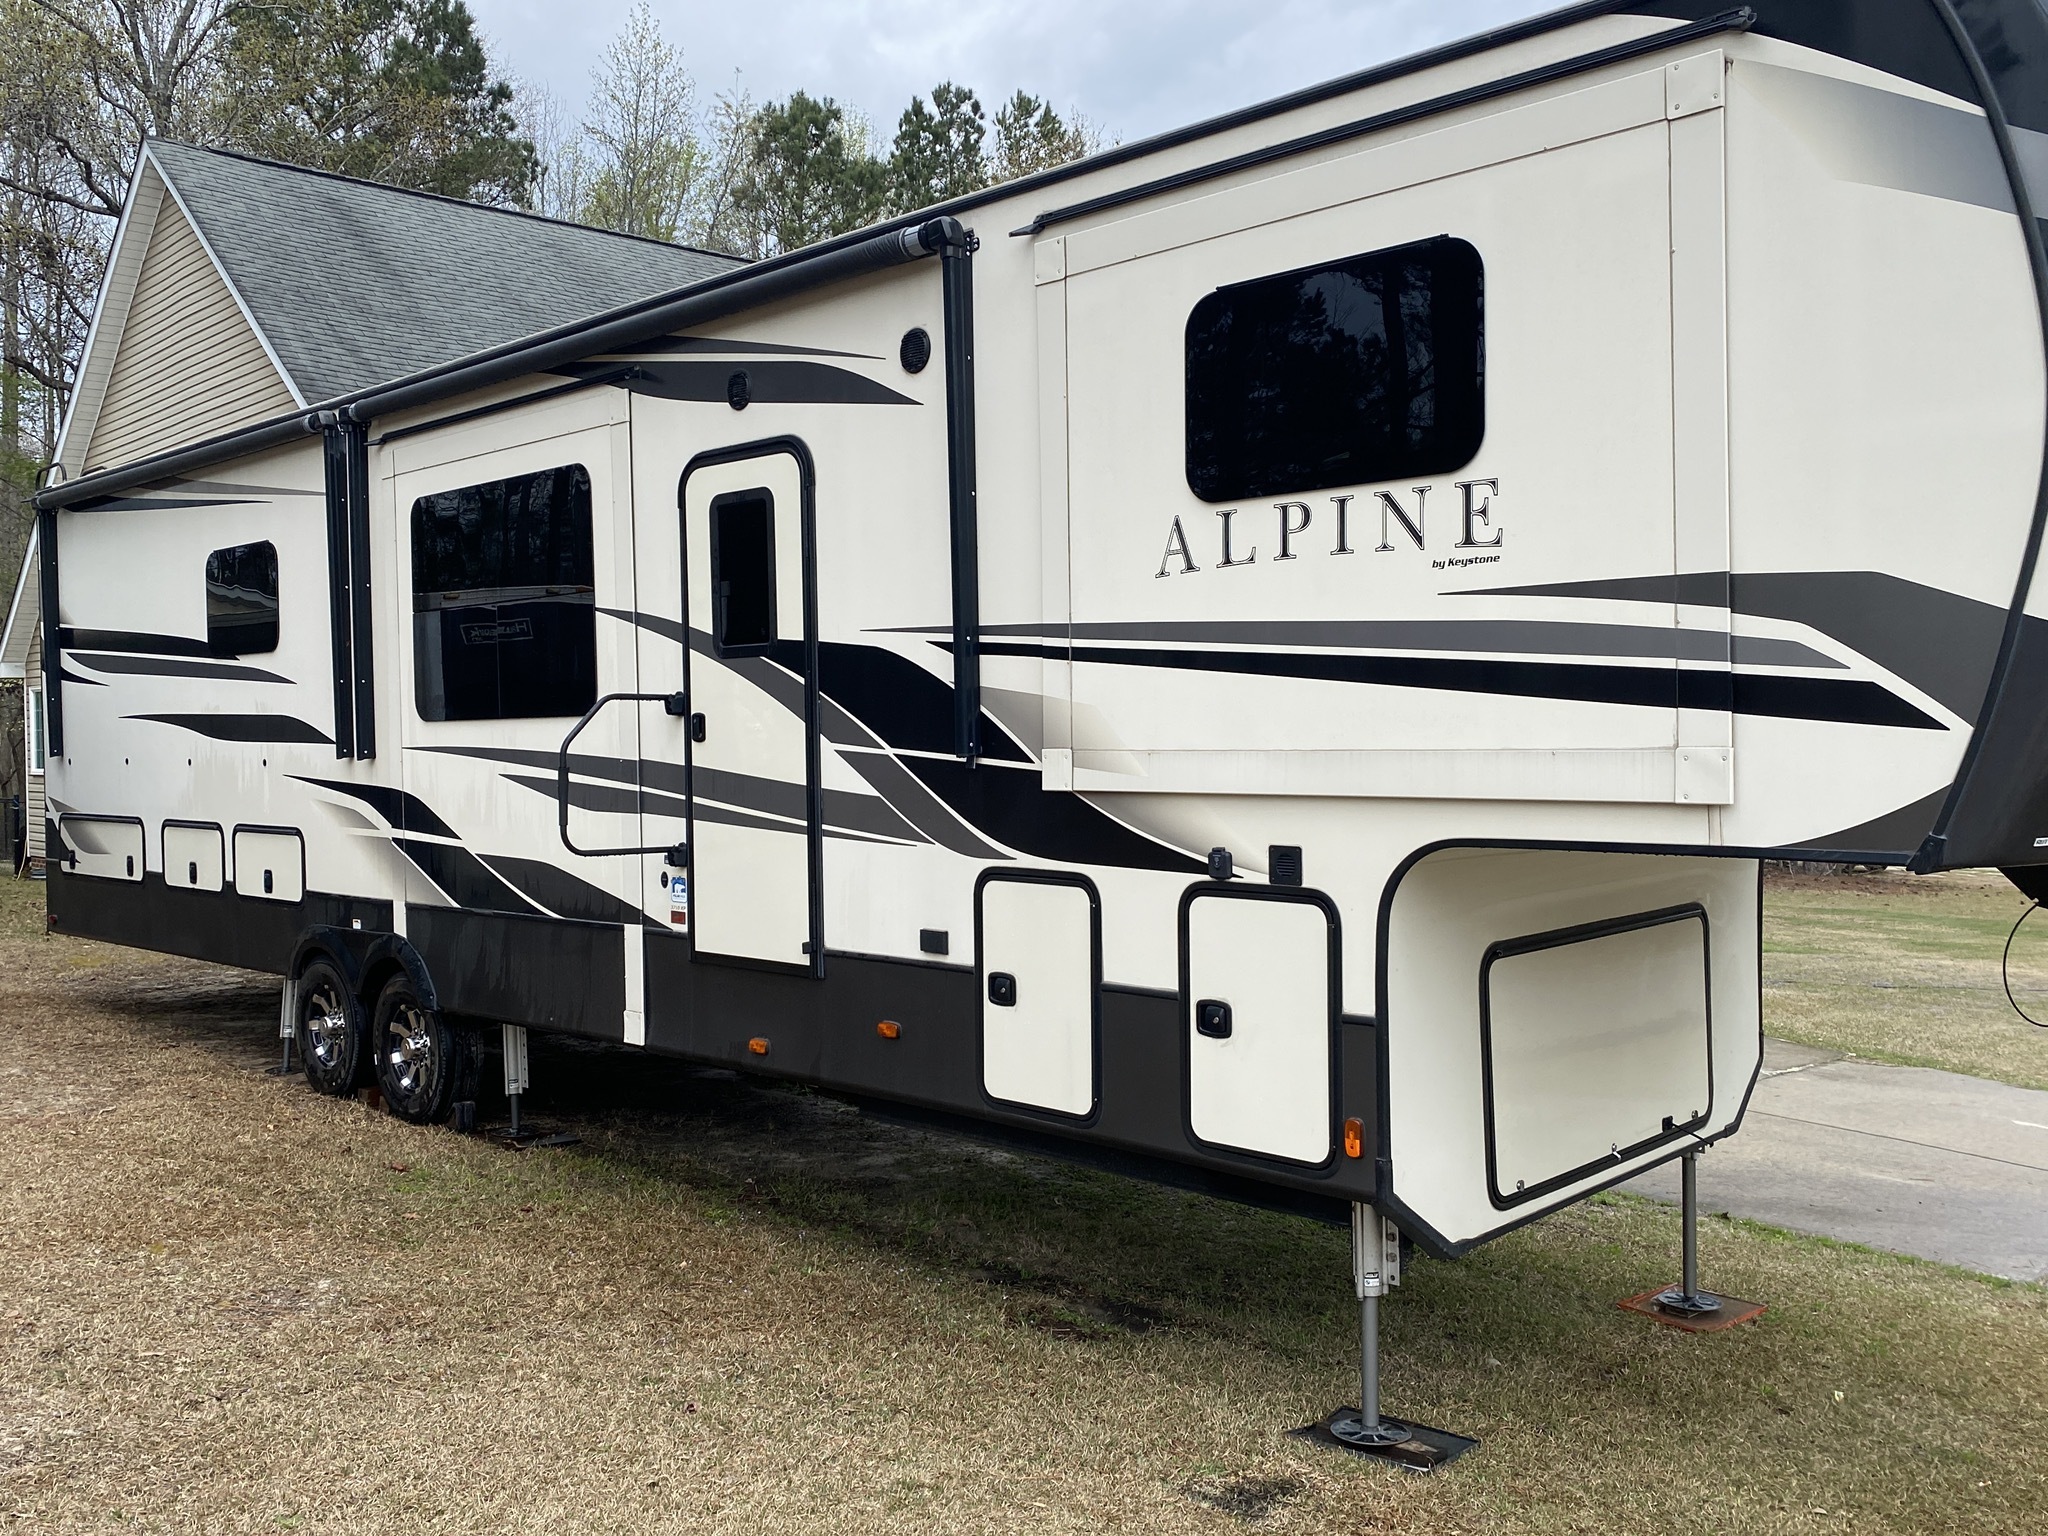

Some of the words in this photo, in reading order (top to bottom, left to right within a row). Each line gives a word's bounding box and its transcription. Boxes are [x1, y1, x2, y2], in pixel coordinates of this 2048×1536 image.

[1155, 478, 1503, 578] ALPINE
[1432, 560, 1445, 570] by
[1448, 555, 1500, 568] Keystone
